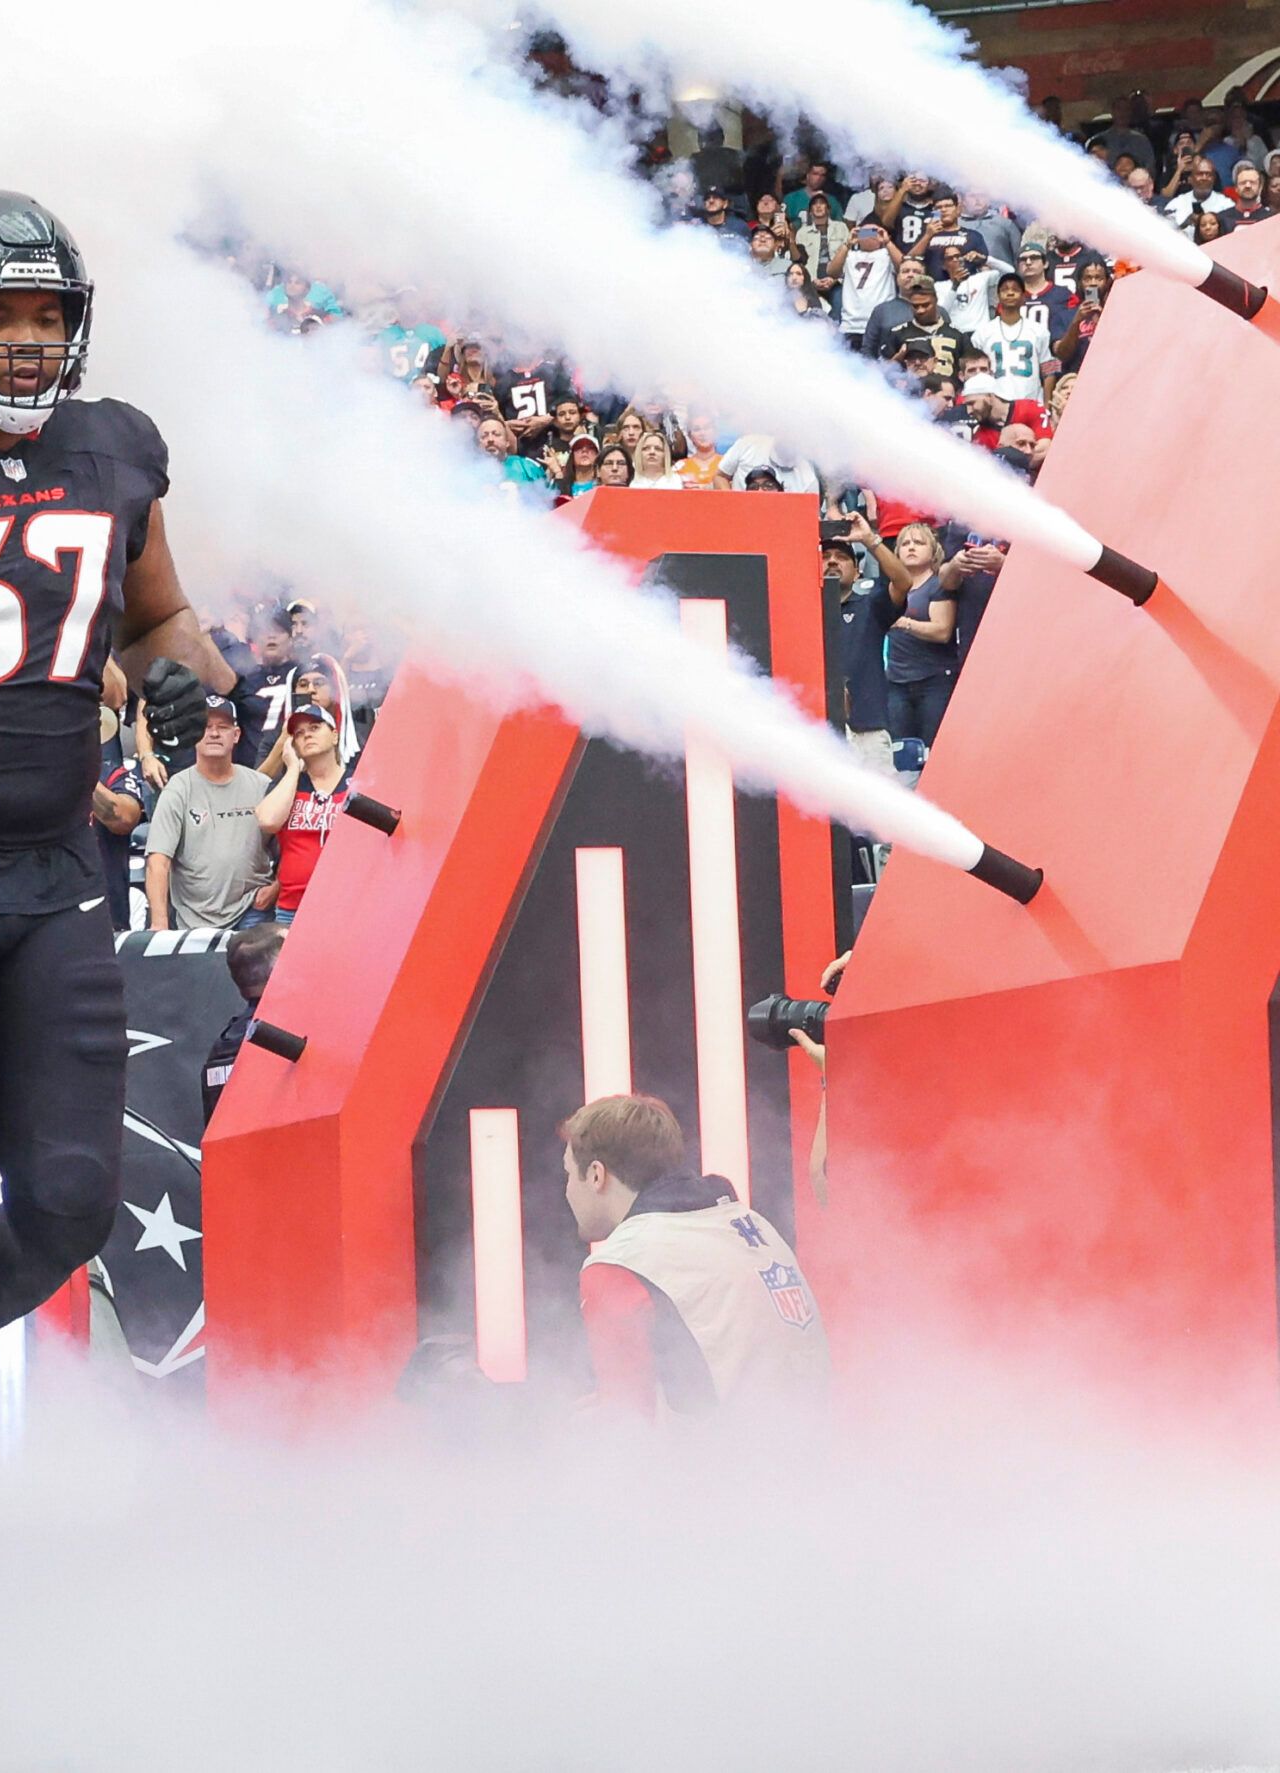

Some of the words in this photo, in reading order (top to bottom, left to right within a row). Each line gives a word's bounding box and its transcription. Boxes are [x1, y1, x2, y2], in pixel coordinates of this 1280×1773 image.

[854, 262, 873, 289] 7
[991, 340, 1034, 379] 13
[511, 381, 547, 419] 51
[217, 810, 256, 819] TEXA
[773, 1287, 811, 1322] NFL
